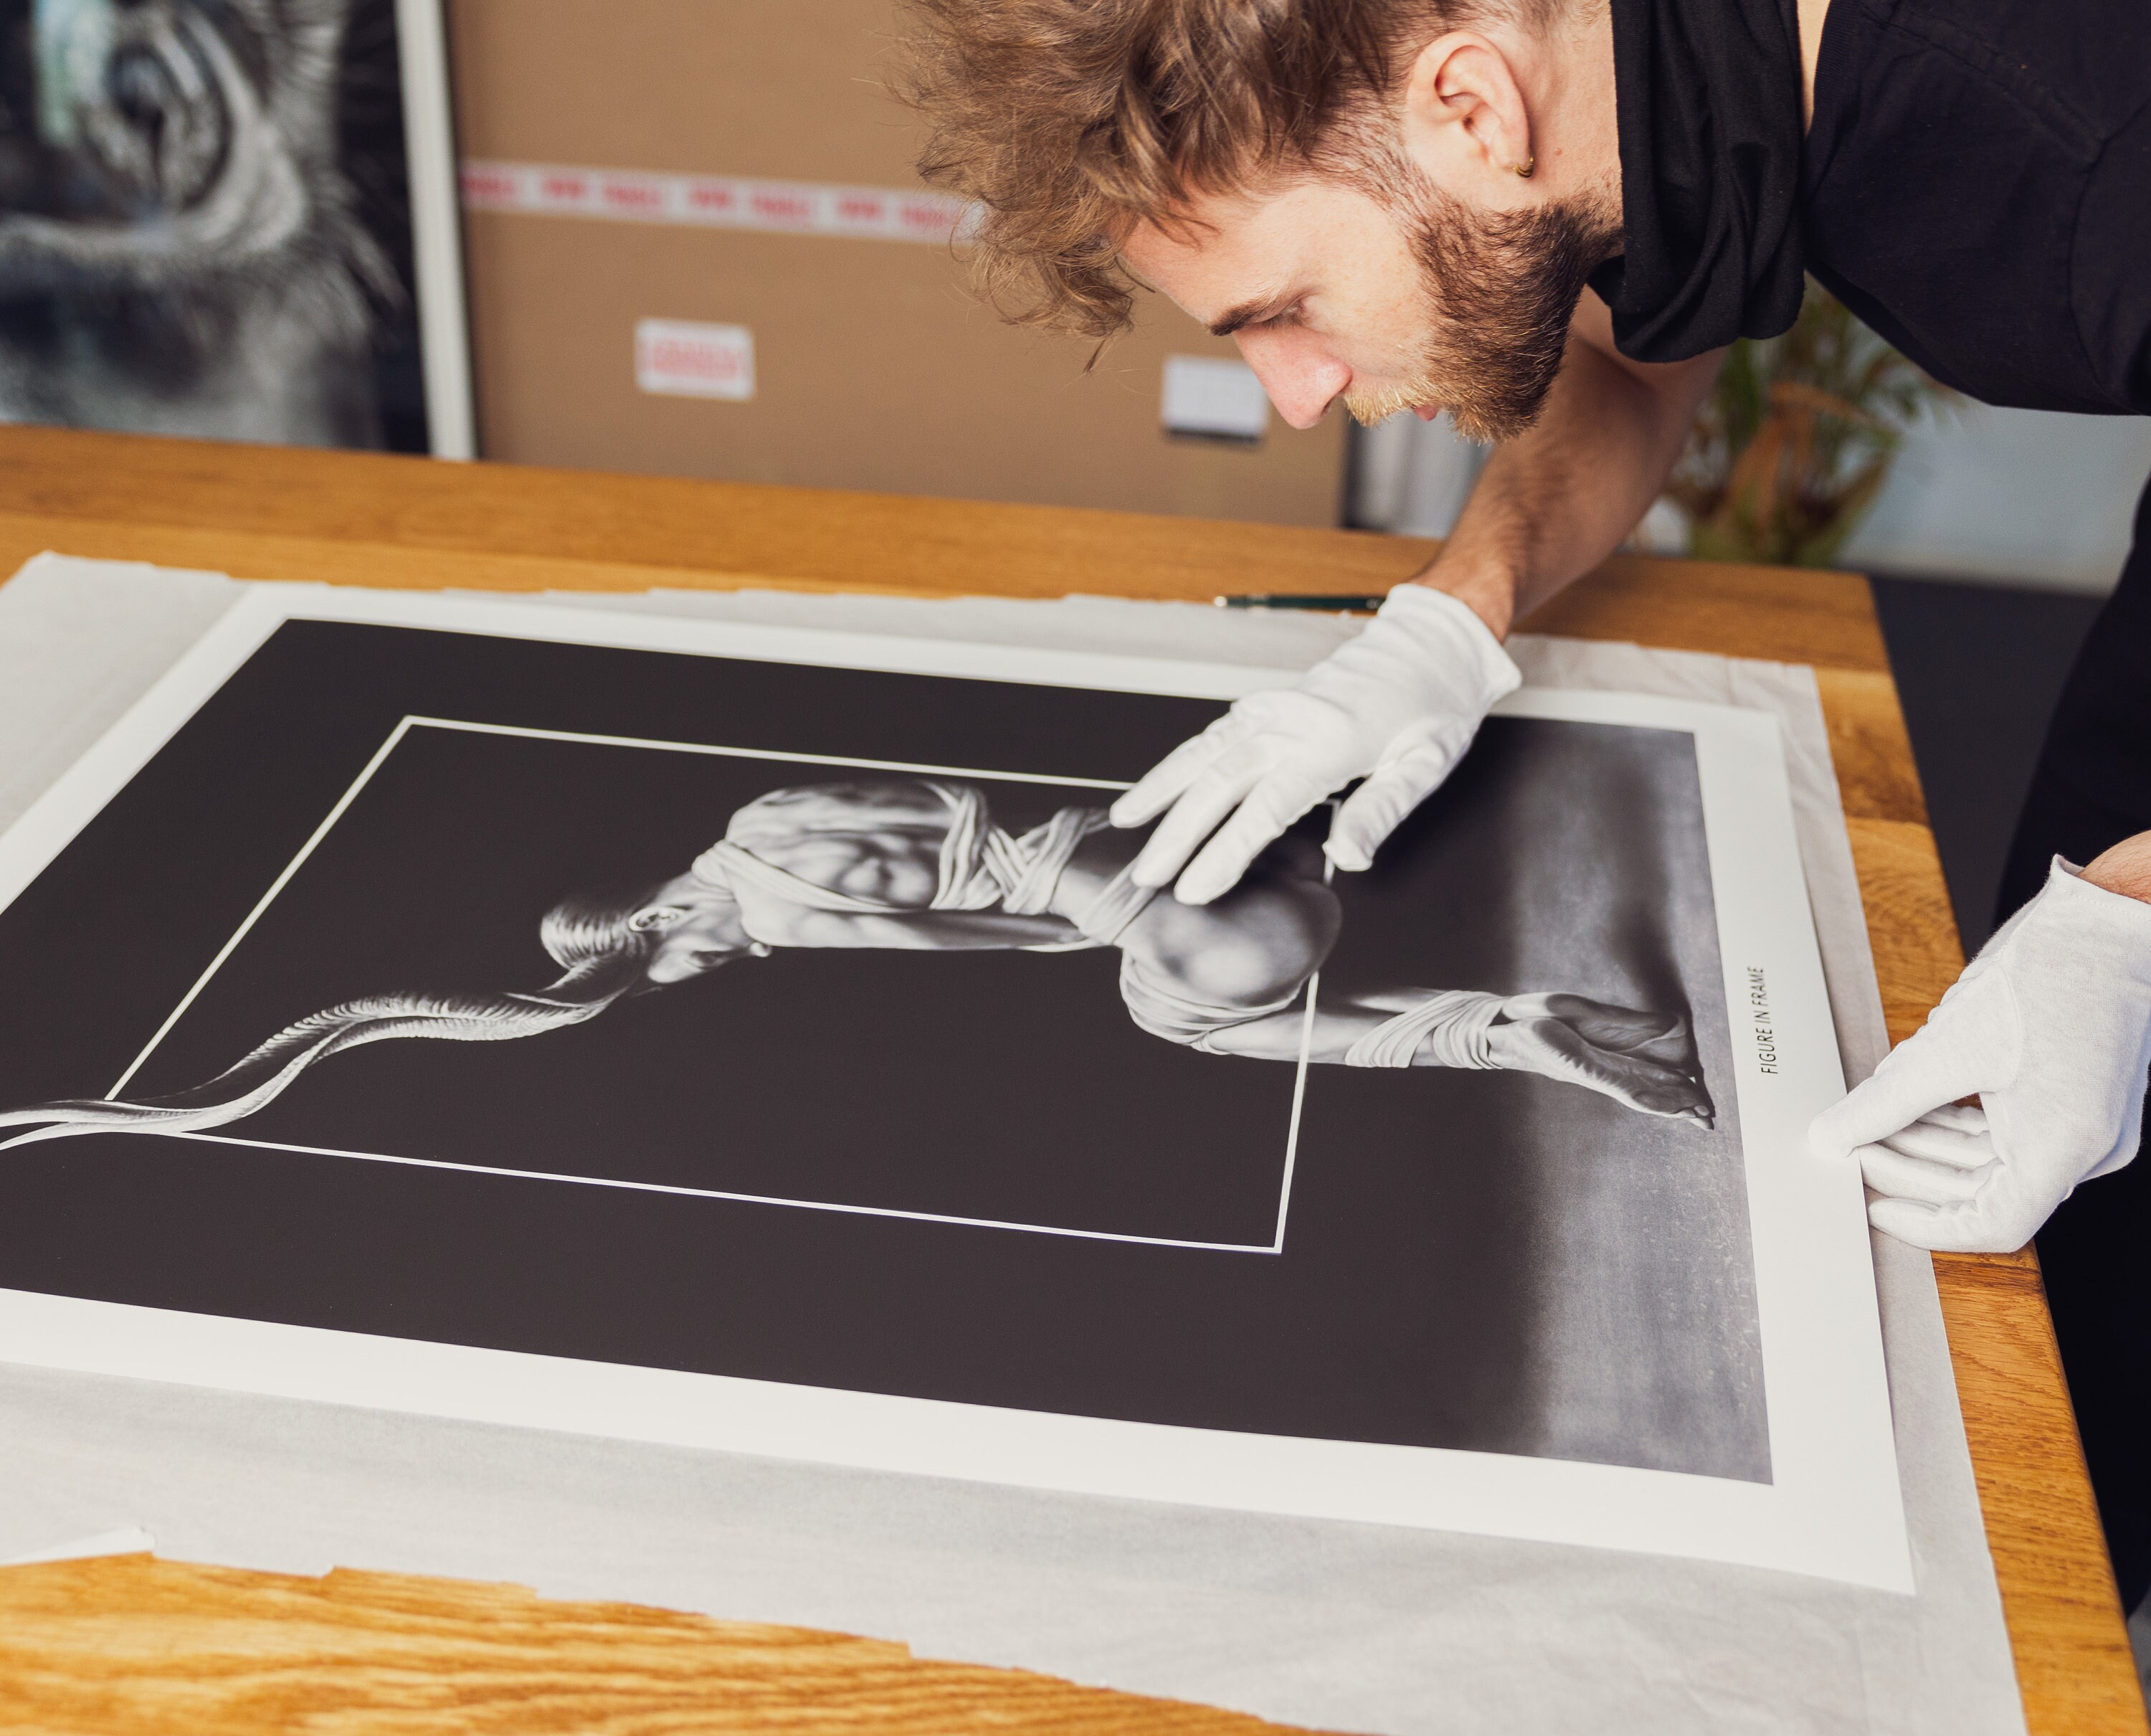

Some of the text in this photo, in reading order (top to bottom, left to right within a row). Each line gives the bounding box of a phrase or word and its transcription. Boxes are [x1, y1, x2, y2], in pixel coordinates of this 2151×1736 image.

[1747, 967, 1778, 1074] FIGURE IN FRAME
